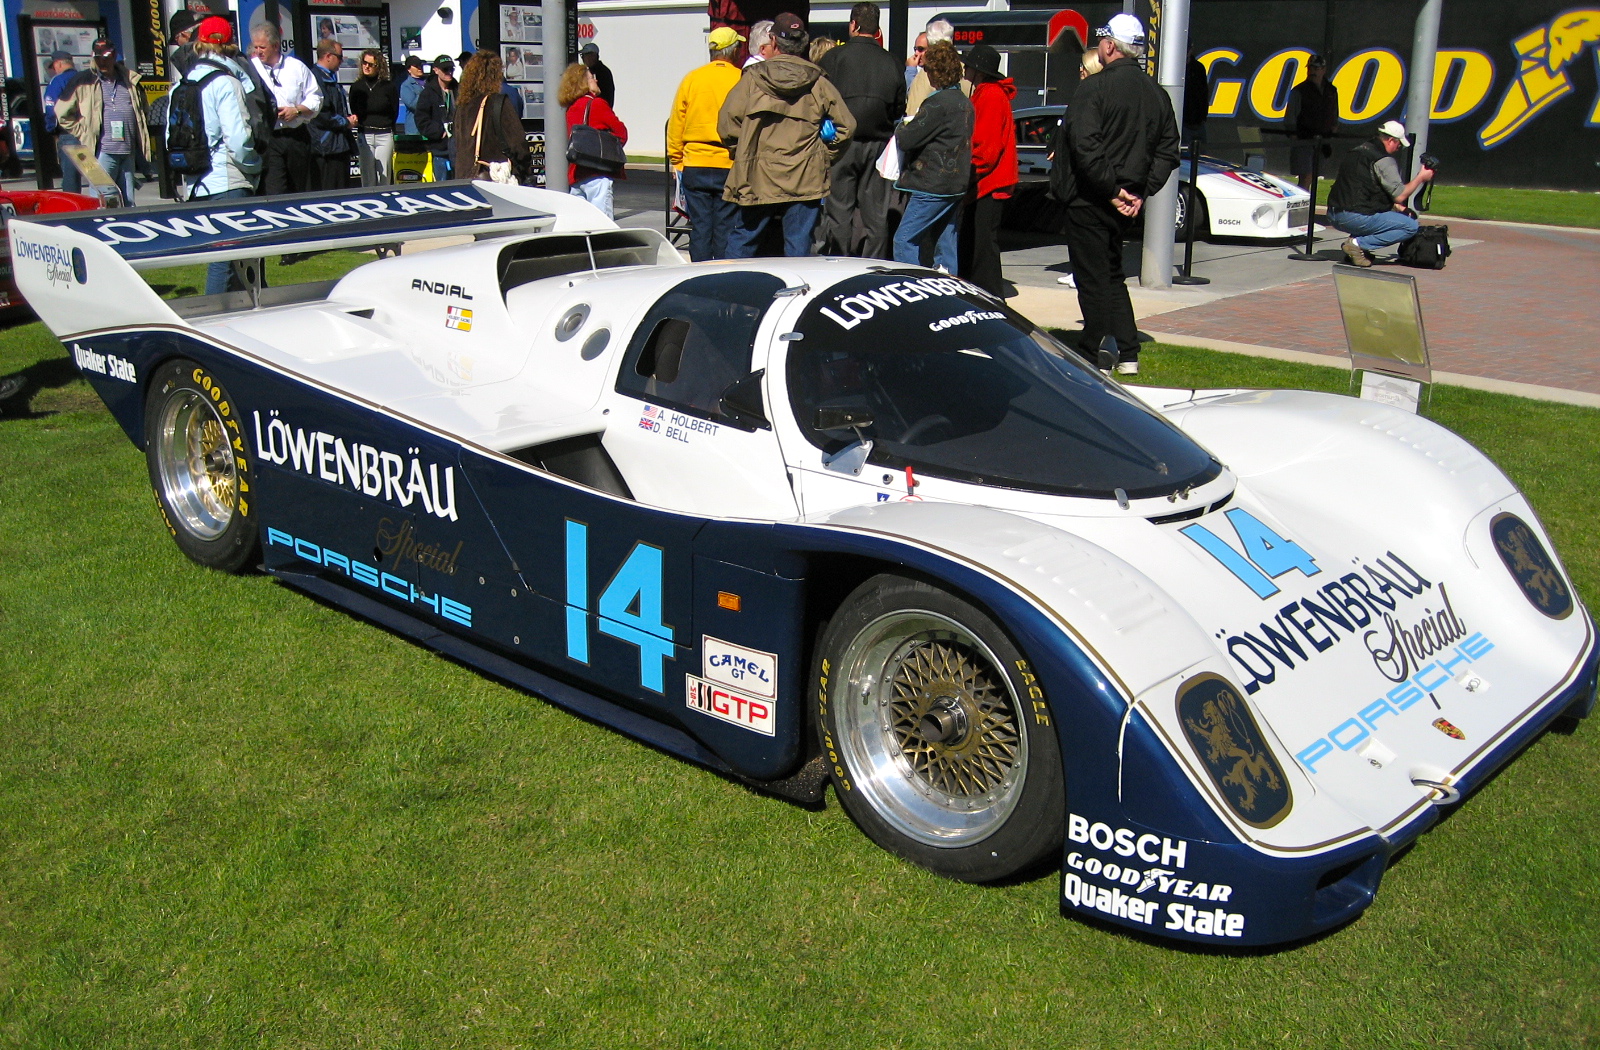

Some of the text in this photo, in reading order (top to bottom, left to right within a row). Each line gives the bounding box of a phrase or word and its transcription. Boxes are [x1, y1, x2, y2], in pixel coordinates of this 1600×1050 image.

[15, 236, 71, 266] LÖWENBRÄU
[47, 263, 72, 287] Special
[411, 279, 473, 300] ANDIAL
[74, 343, 137, 383] Quaker State
[653, 422, 690, 443] D. BELL
[657, 410, 720, 436] A. HOLBERT
[253, 409, 459, 522] LÖWENBRÄU
[376, 517, 464, 577] Special
[1177, 507, 1322, 600] 14
[267, 526, 472, 628] PORSCHE
[564, 516, 676, 697] 14
[709, 654, 770, 683] CAMEL
[1363, 581, 1467, 709] Special
[731, 668, 745, 680] GT
[1014, 659, 1050, 727] EAGLE
[713, 690, 769, 723] GTP
[1295, 631, 1495, 774] PORSCHE
[1068, 813, 1187, 868] BOSCH
[1067, 852, 1233, 902] GOODYEAR
[1064, 872, 1245, 937] Quaker State
